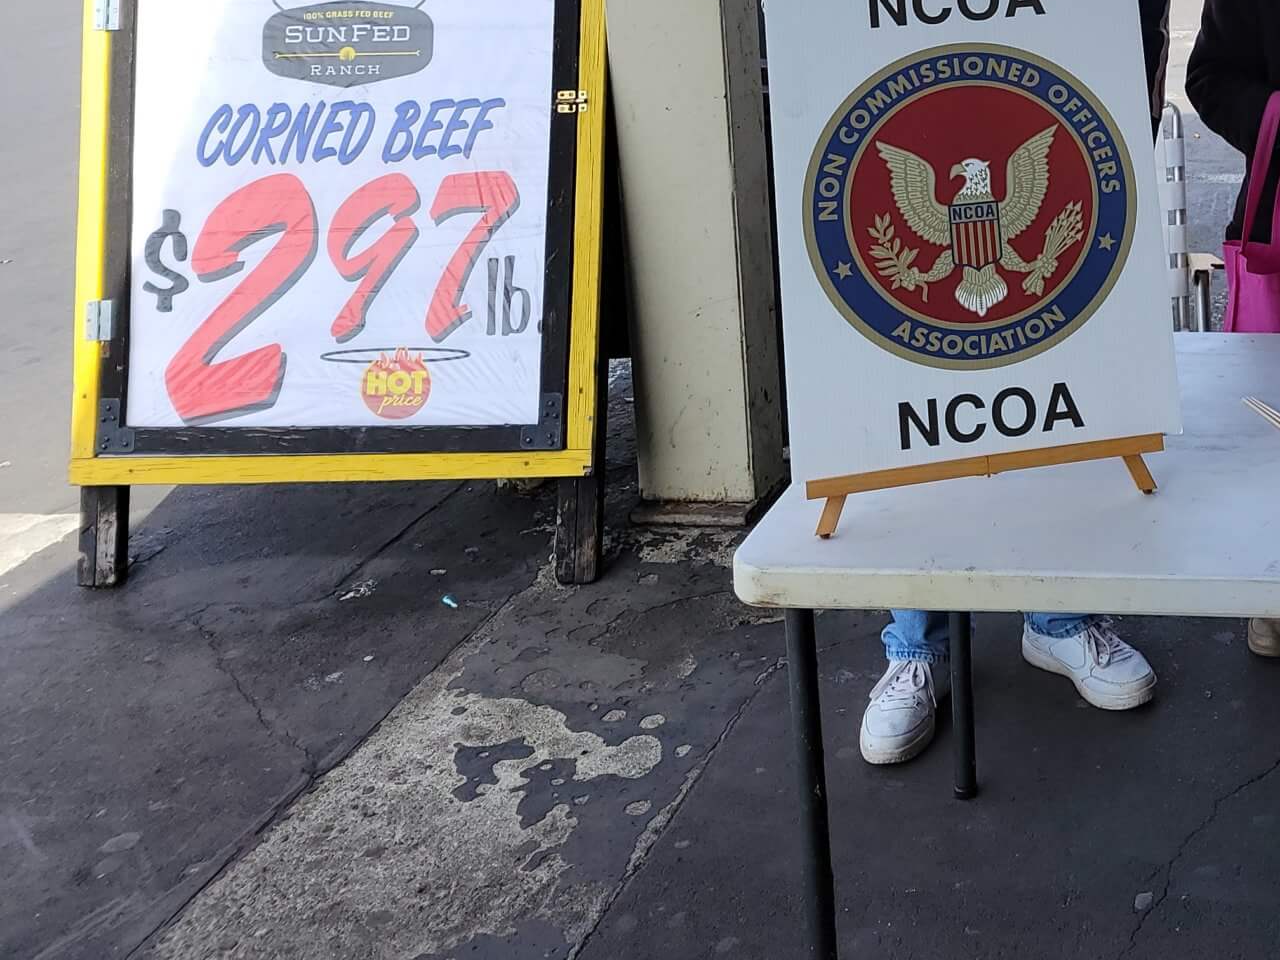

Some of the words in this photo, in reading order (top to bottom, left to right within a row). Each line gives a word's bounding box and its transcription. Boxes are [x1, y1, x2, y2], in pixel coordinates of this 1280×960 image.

[326, 10, 353, 19] GRASS
[355, 10, 372, 18] FED
[373, 10, 395, 19] BEEF
[310, 64, 381, 76] RANCH
[198, 101, 376, 167] CORNED
[382, 98, 506, 163] BEEF
[818, 153, 847, 222] NON
[839, 56, 1041, 144] COMMISSIONED
[1047, 84, 1121, 194] OFFICERS
[952, 206, 996, 221] NCOA
[891, 304, 1067, 356] ASSOCIATION
[366, 370, 428, 396] HOT
[377, 394, 422, 414] price
[898, 382, 1085, 450] NCOA
